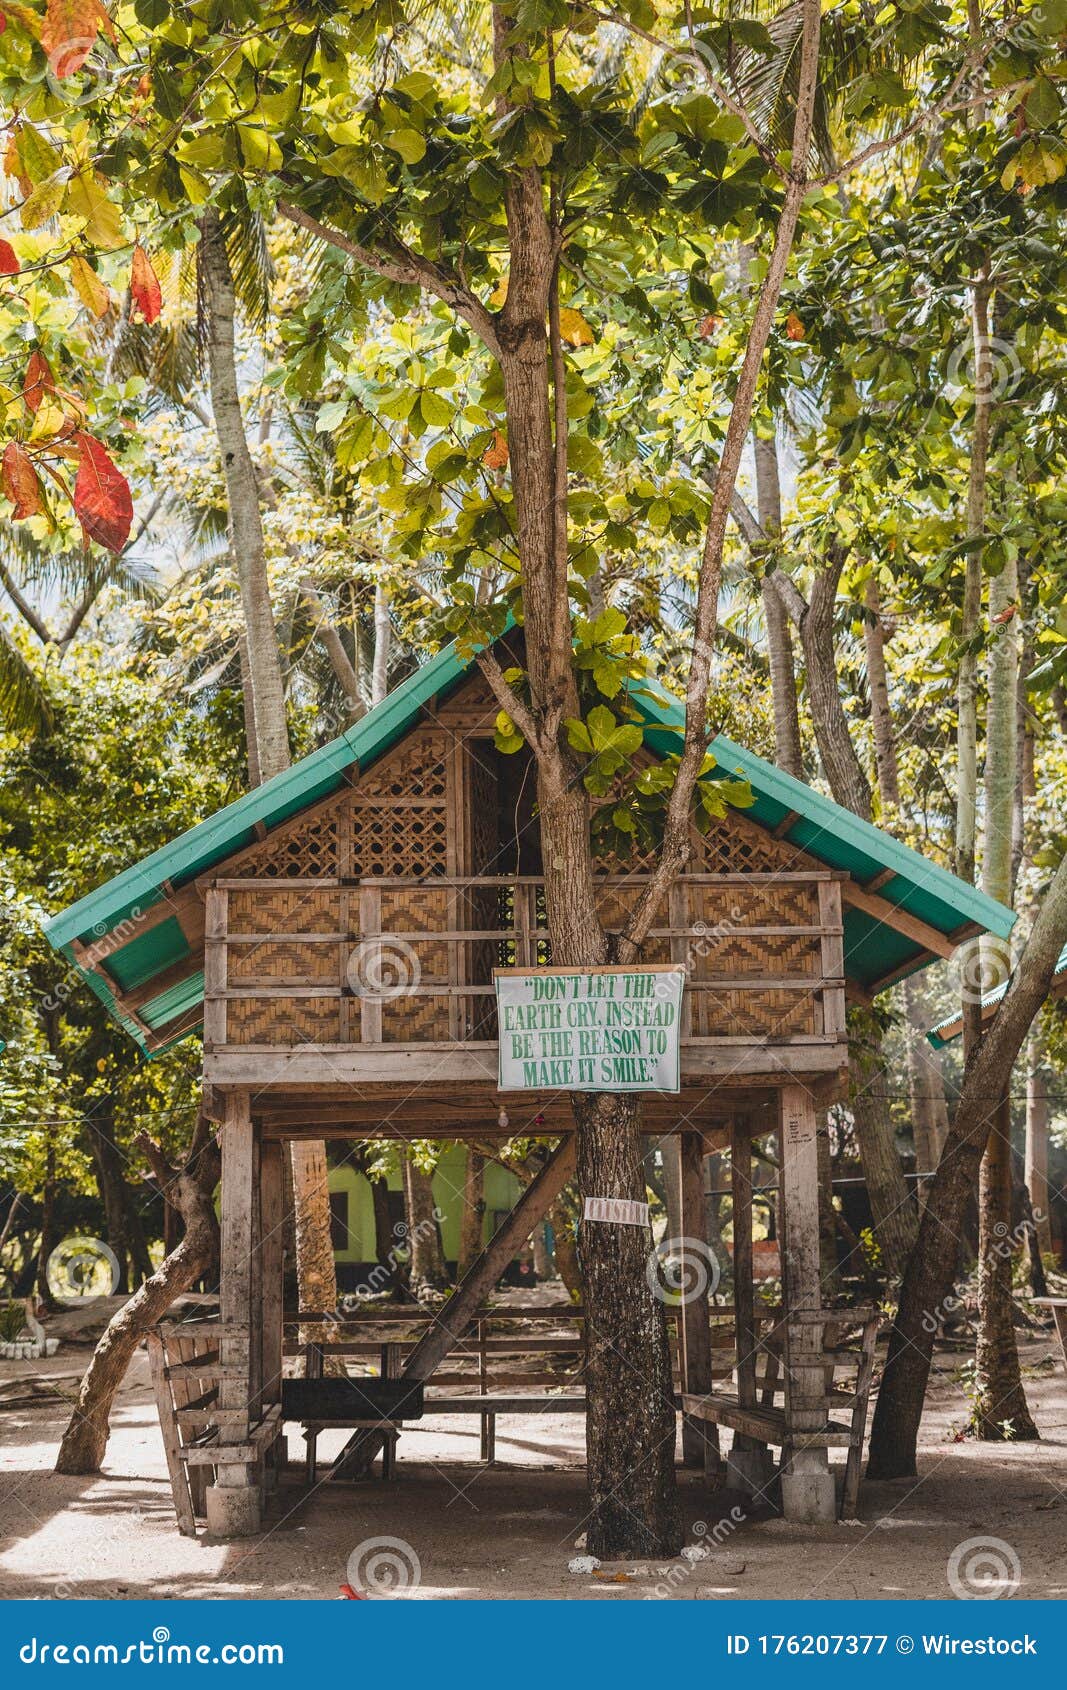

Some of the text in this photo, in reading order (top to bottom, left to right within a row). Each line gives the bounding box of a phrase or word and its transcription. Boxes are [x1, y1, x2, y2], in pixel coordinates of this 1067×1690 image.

[587, 975, 617, 998] LET
[623, 974, 656, 998] THE
[504, 1001, 675, 1031] EARTH CRY. INSTEAD
[511, 1029, 667, 1059] BE THE REASON TO
[522, 1060, 573, 1088] MAKE
[578, 1059, 595, 1083] IT
